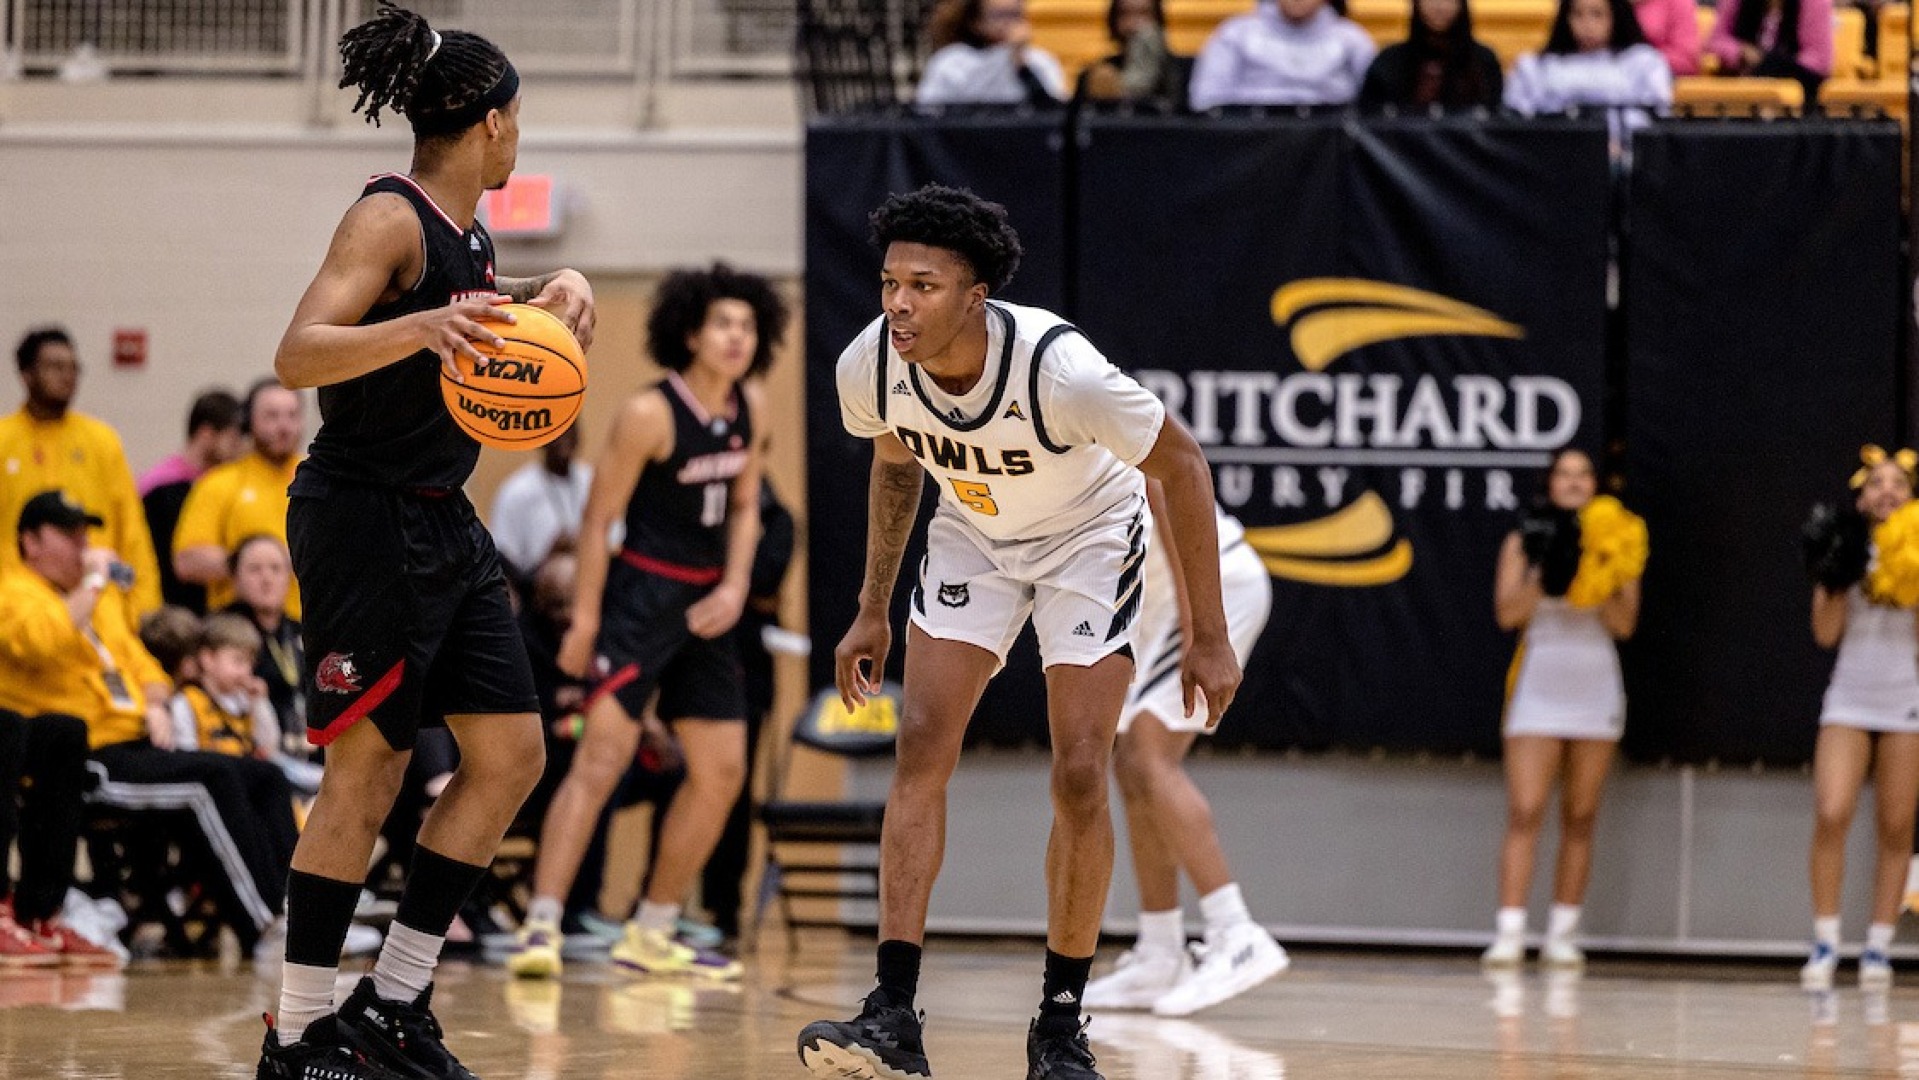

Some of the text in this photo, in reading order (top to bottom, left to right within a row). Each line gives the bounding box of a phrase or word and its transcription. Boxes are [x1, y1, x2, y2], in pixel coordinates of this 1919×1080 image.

[473, 358, 544, 385] NCAA
[456, 392, 553, 431] Wilson
[1137, 369, 1583, 450] RITCHARD
[948, 477, 999, 517] 5
[1218, 463, 1520, 511] URY FIR
